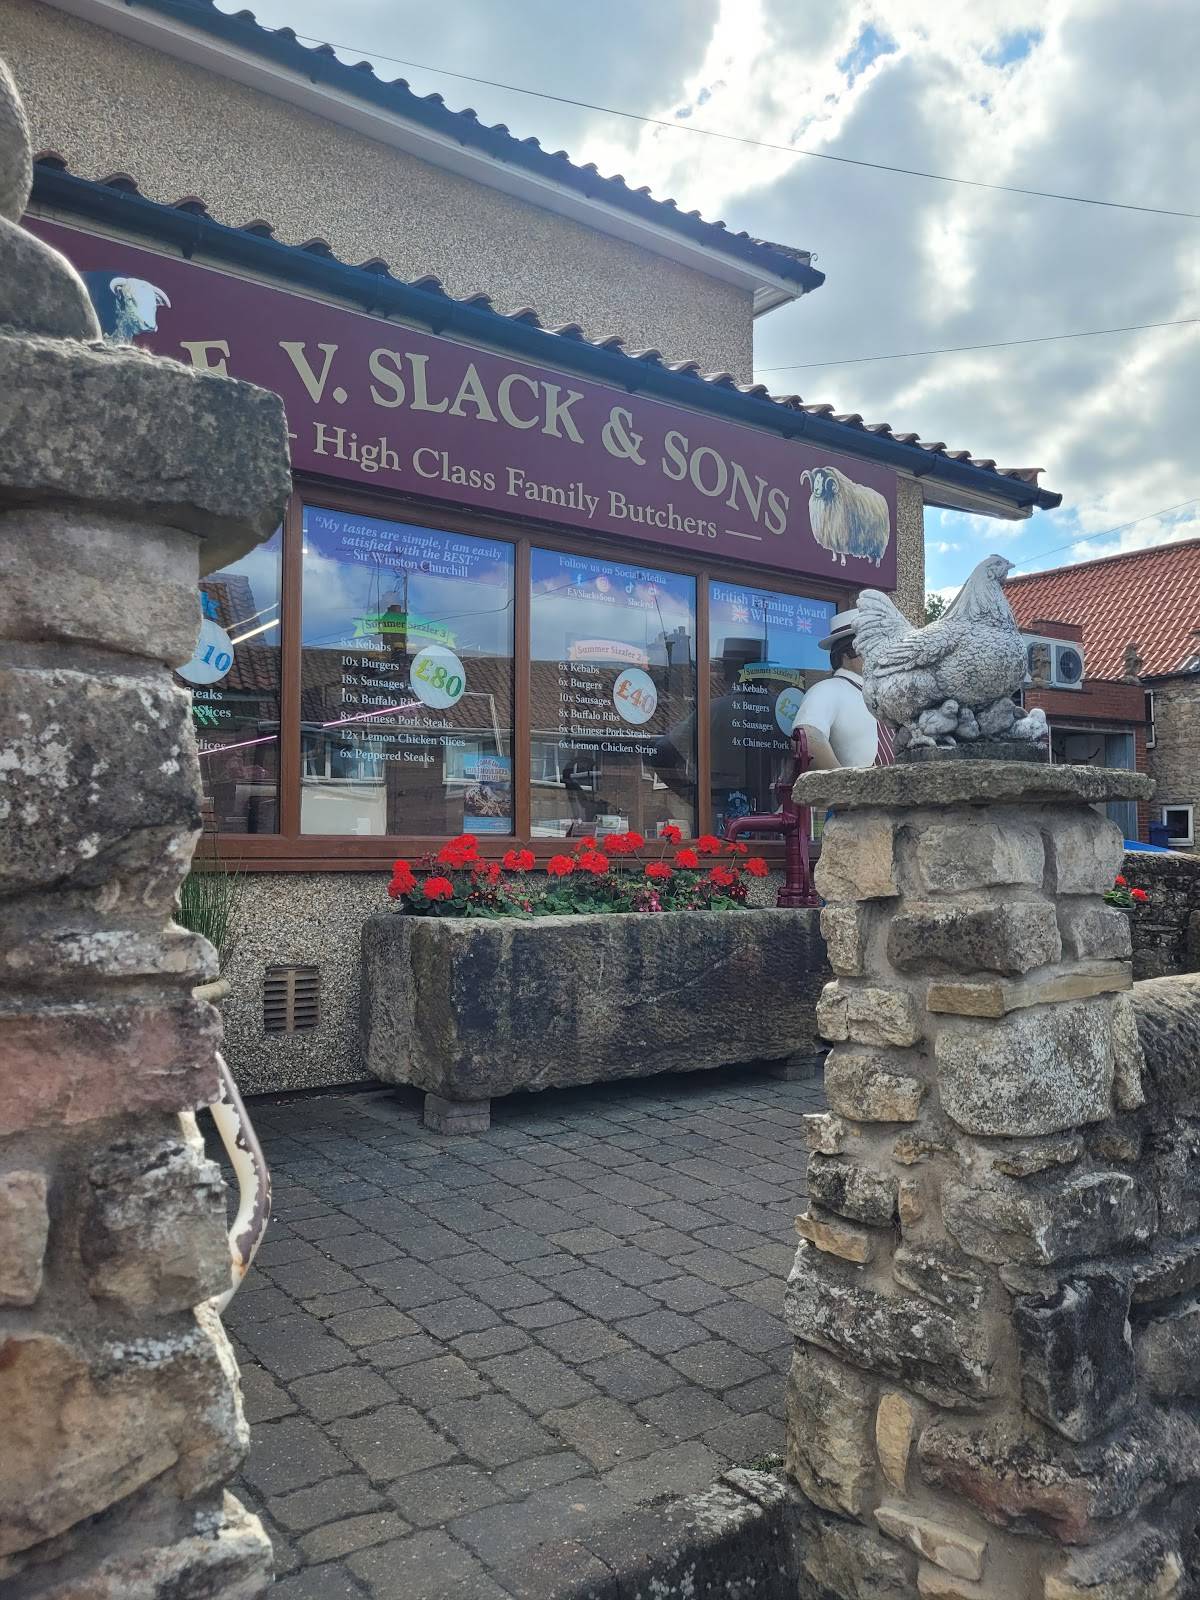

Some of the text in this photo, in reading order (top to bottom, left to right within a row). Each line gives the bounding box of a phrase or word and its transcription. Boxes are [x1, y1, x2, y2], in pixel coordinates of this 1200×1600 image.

[278, 341, 348, 404] V.
[369, 349, 584, 443] SLACK
[602, 407, 646, 465] &
[662, 431, 789, 535] SONS
[313, 422, 717, 538] High Class Family Butchers
[341, 536, 392, 552] satisfied
[395, 544, 420, 557] with
[423, 548, 440, 560] the
[344, 523, 378, 537] tastes
[381, 531, 400, 541] are
[402, 533, 441, 550] simple,
[452, 543, 470, 553] am
[472, 547, 502, 560] easily
[353, 549, 371, 561] Sir
[371, 551, 418, 569] Winston
[421, 559, 469, 577] Churchill
[559, 556, 667, 585] Follow us on Social Media
[713, 588, 827, 620] British Farming Award
[365, 620, 405, 630] Summer
[750, 607, 794, 627] Winners
[355, 639, 392, 652] Kebabs
[577, 645, 610, 655] Summer
[341, 656, 400, 671] 10x Burgers
[558, 661, 600, 675] 6x Kebabs
[341, 674, 405, 690] 18x Sausages
[414, 657, 463, 698] £80
[558, 677, 603, 691] 6x Burgers
[616, 679, 655, 713] £40
[731, 682, 768, 695] 4x Kebabs
[341, 692, 359, 704] 10x
[361, 695, 398, 707] Buffalo
[559, 692, 612, 707] 10x Sausages
[731, 700, 770, 713] 4x Burgers
[340, 710, 454, 729] 8x Chinese Pork Steaks
[558, 708, 620, 722] 8x Buffalo Ribs
[558, 723, 651, 739] 6x Chinese Pork Steaks
[731, 718, 774, 732] 6x Sausages
[341, 730, 466, 747] 12x Lemon Chicken Slices
[731, 736, 790, 750] 4x Chinese Pork
[340, 748, 435, 763] 6x Peppered Steaks
[559, 740, 658, 756] 6x Lemon Chicken Strips
